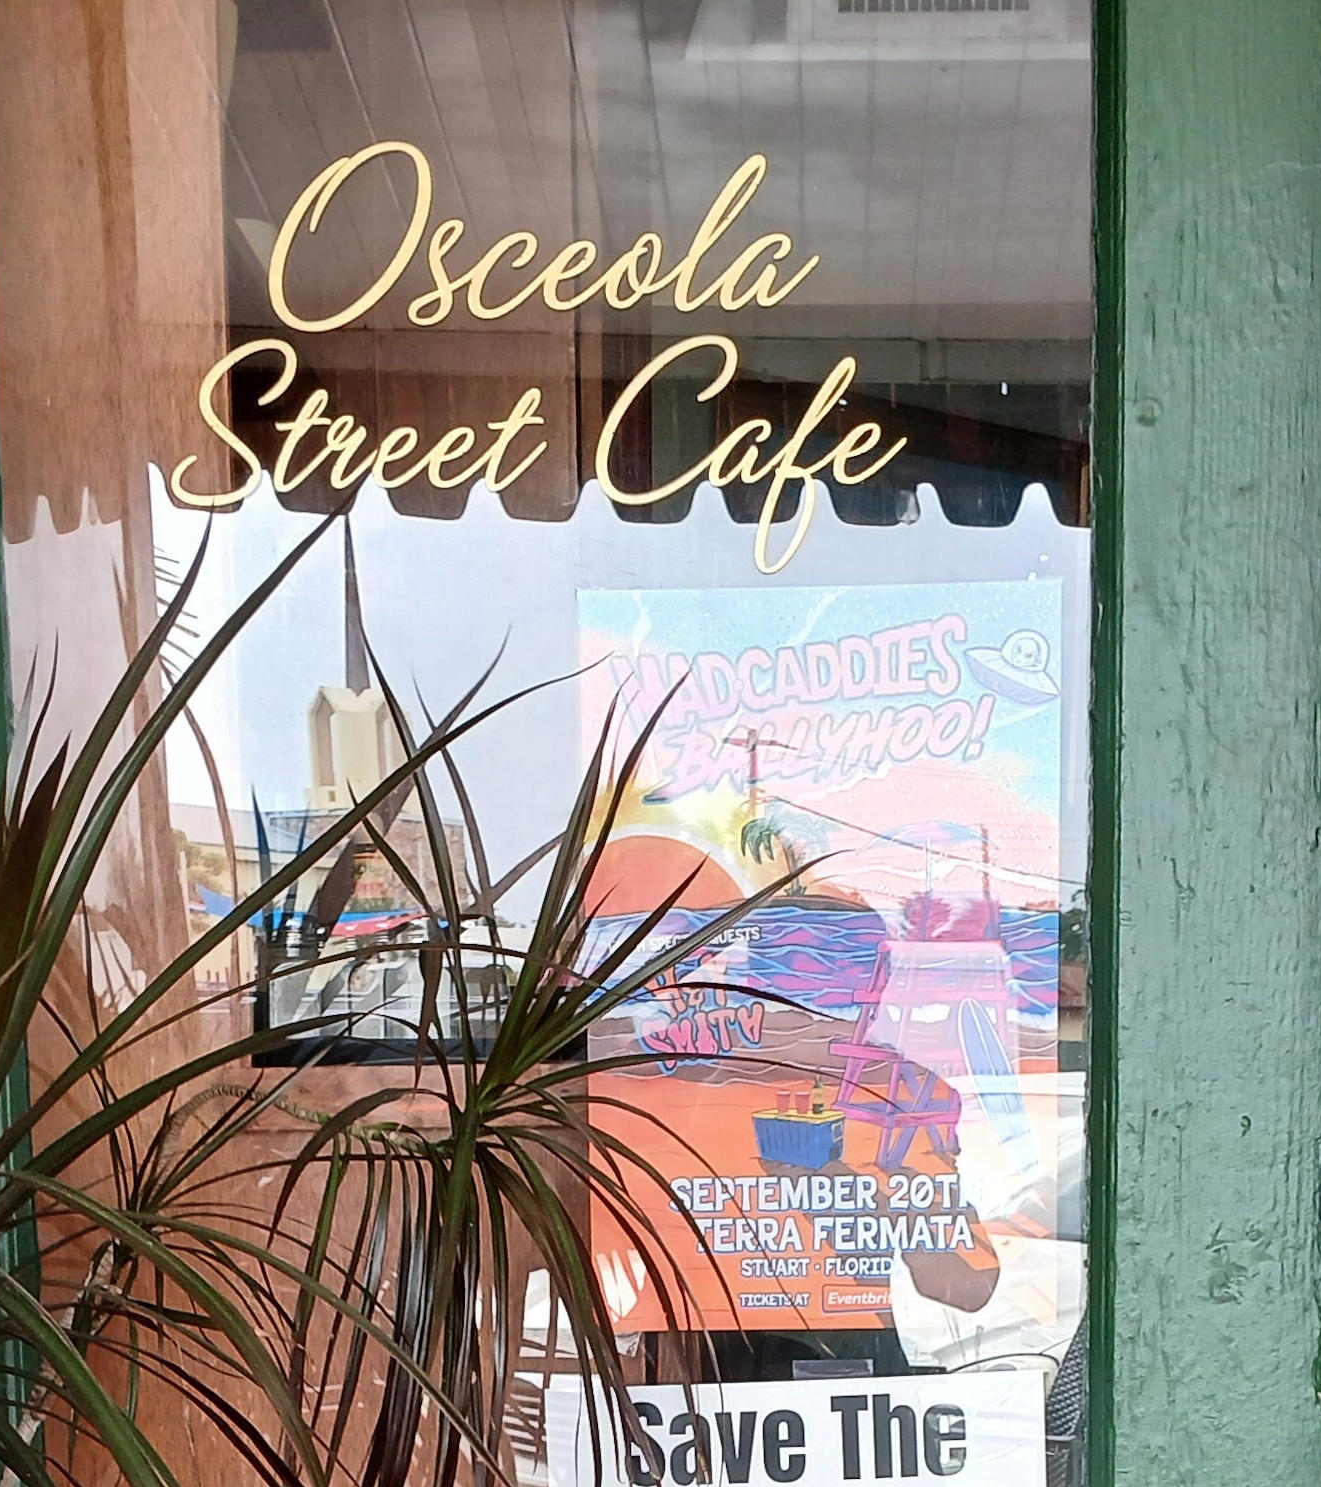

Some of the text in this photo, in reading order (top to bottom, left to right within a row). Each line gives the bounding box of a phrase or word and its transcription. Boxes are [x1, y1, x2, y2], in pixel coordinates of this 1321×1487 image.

[268, 141, 820, 334] Osceola
[171, 334, 908, 575] Street Cafe
[669, 1175, 880, 1213] SEPTEMBER
[697, 1214, 975, 1254] TERRA FERMATA
[740, 1256, 895, 1279] STUART FLORID
[628, 1393, 967, 1487] Save The
